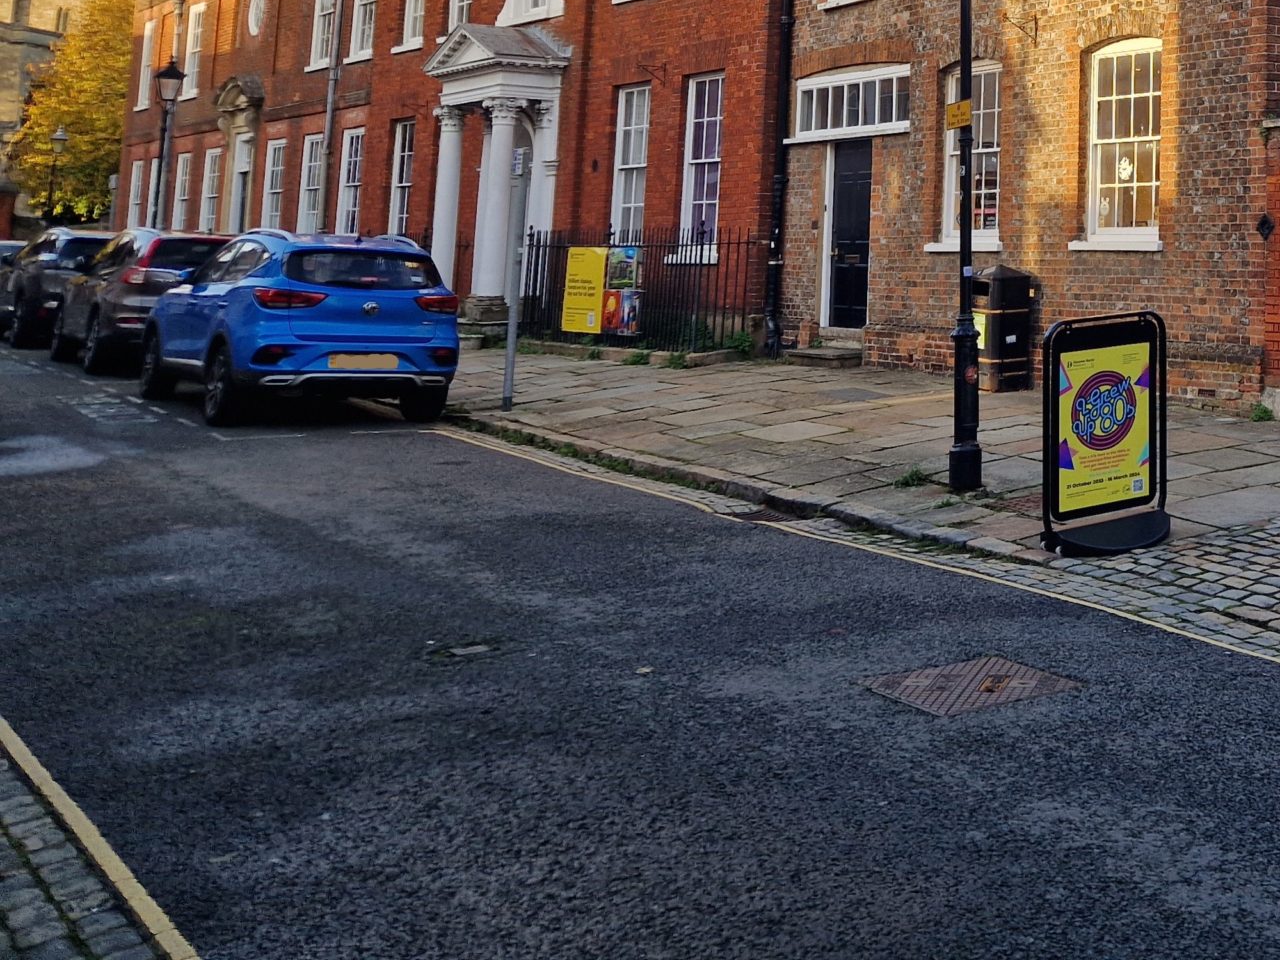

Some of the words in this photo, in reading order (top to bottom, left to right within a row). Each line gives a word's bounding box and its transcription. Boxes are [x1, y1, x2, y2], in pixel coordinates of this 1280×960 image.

[1072, 414, 1095, 443] Up
[1100, 395, 1135, 433] 80s
[1087, 376, 1131, 420] Grew
